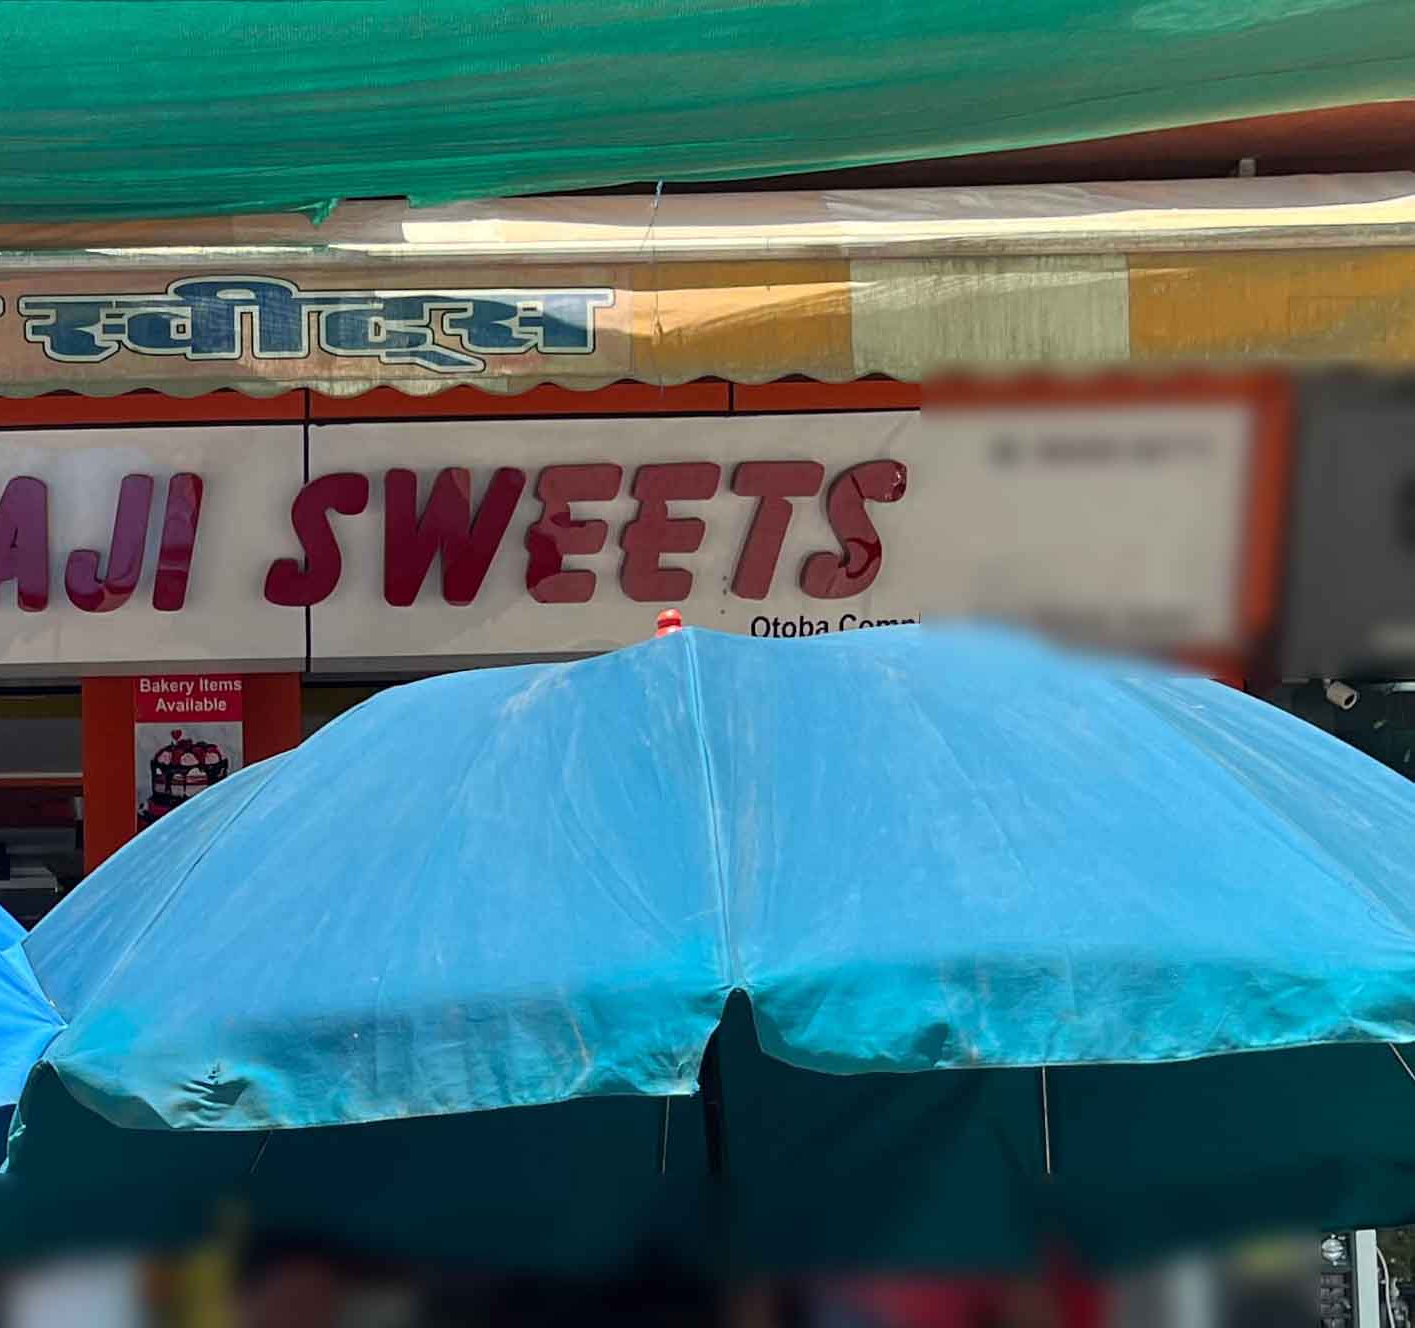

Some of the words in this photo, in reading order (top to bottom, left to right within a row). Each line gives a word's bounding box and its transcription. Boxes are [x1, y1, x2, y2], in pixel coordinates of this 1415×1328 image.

[263, 458, 908, 608] SWEETS
[750, 615, 830, 639] Otoba
[139, 677, 195, 696] Bakery
[199, 677, 243, 692] Items
[155, 697, 227, 713] Available
